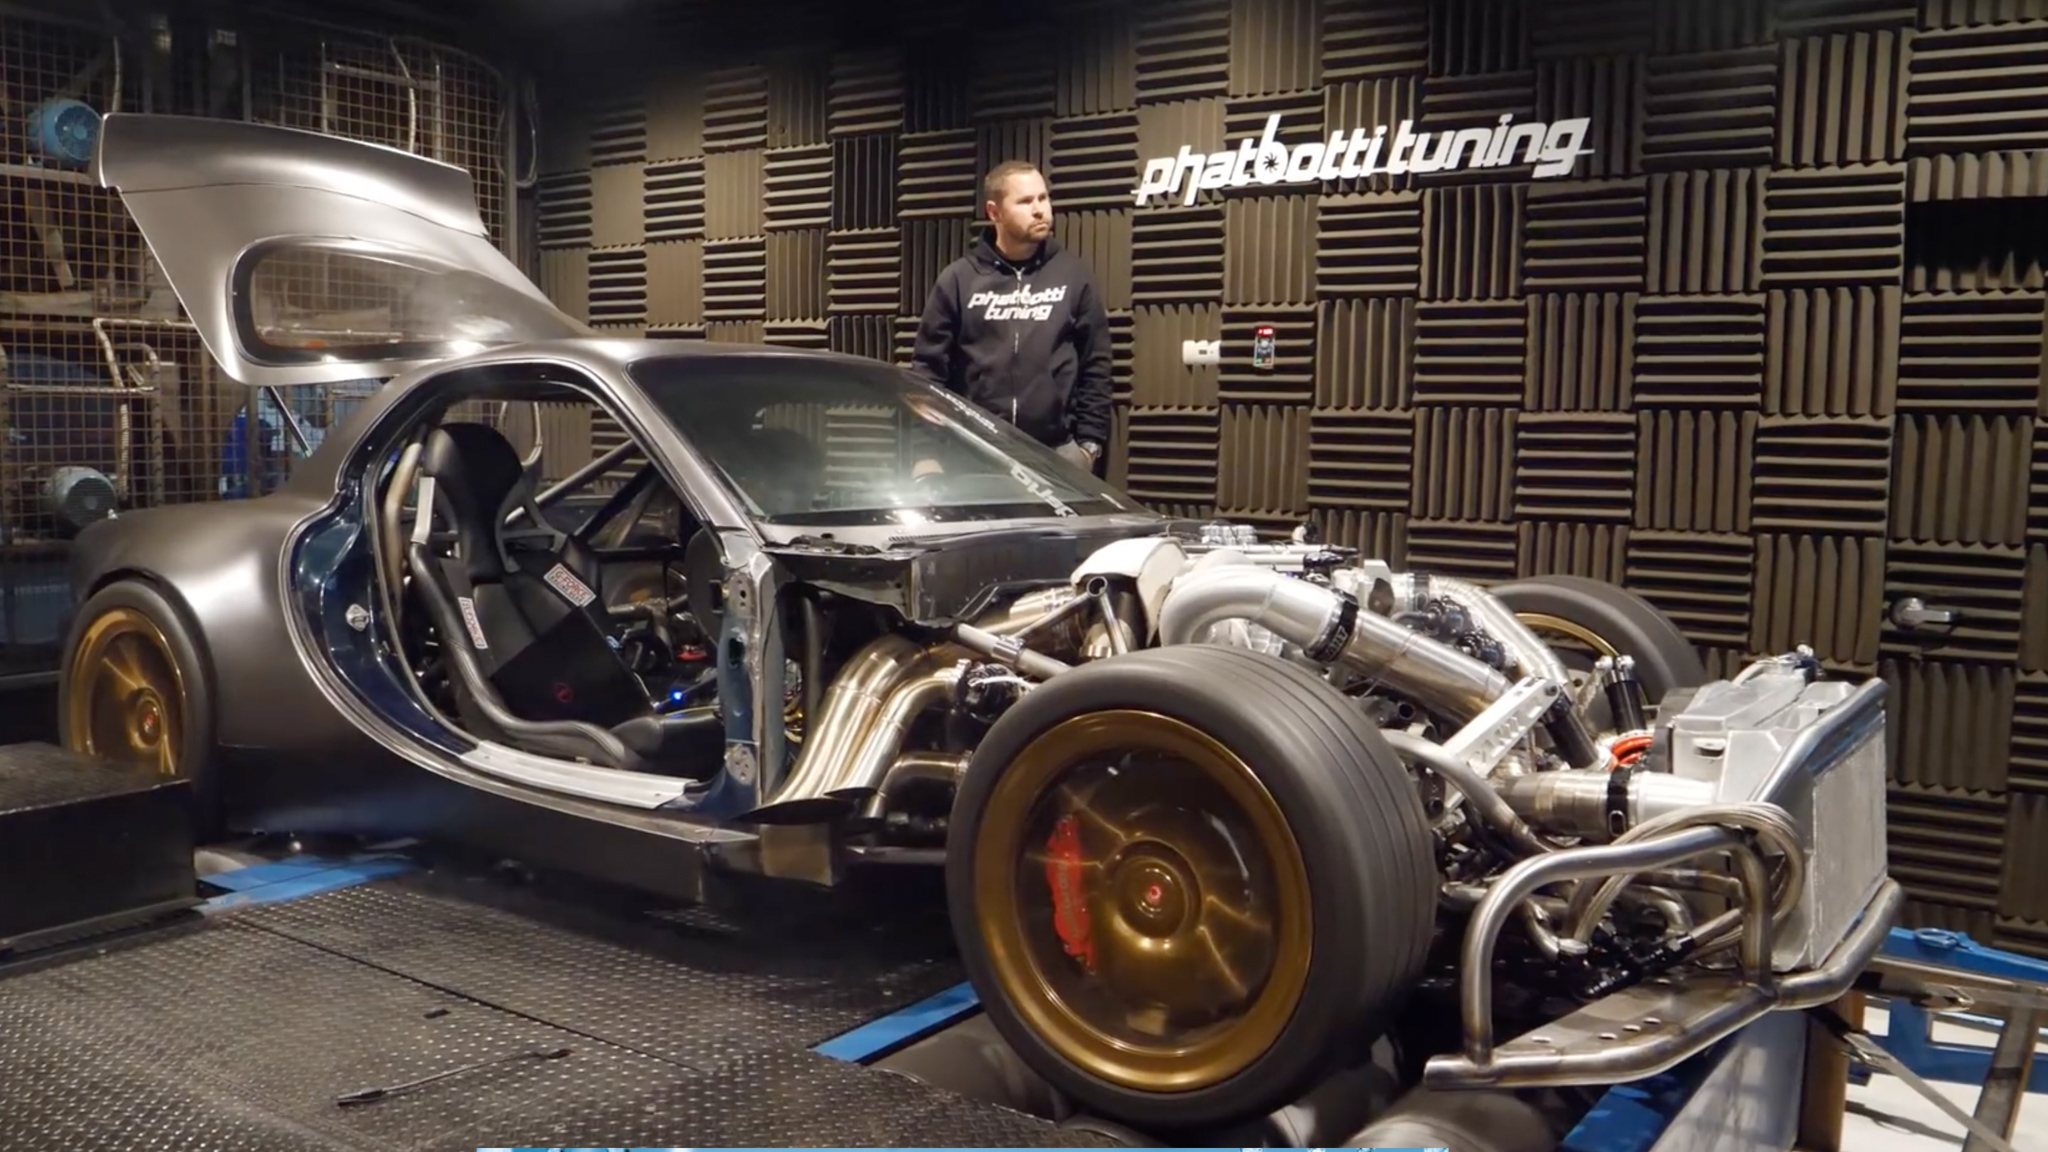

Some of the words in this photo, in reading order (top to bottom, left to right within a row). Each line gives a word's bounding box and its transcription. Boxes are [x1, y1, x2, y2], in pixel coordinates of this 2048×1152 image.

[1132, 113, 1387, 206] phatbotti
[1388, 113, 1594, 178] tuning
[967, 284, 1067, 308] phatbotti
[984, 305, 1053, 320] tuning
